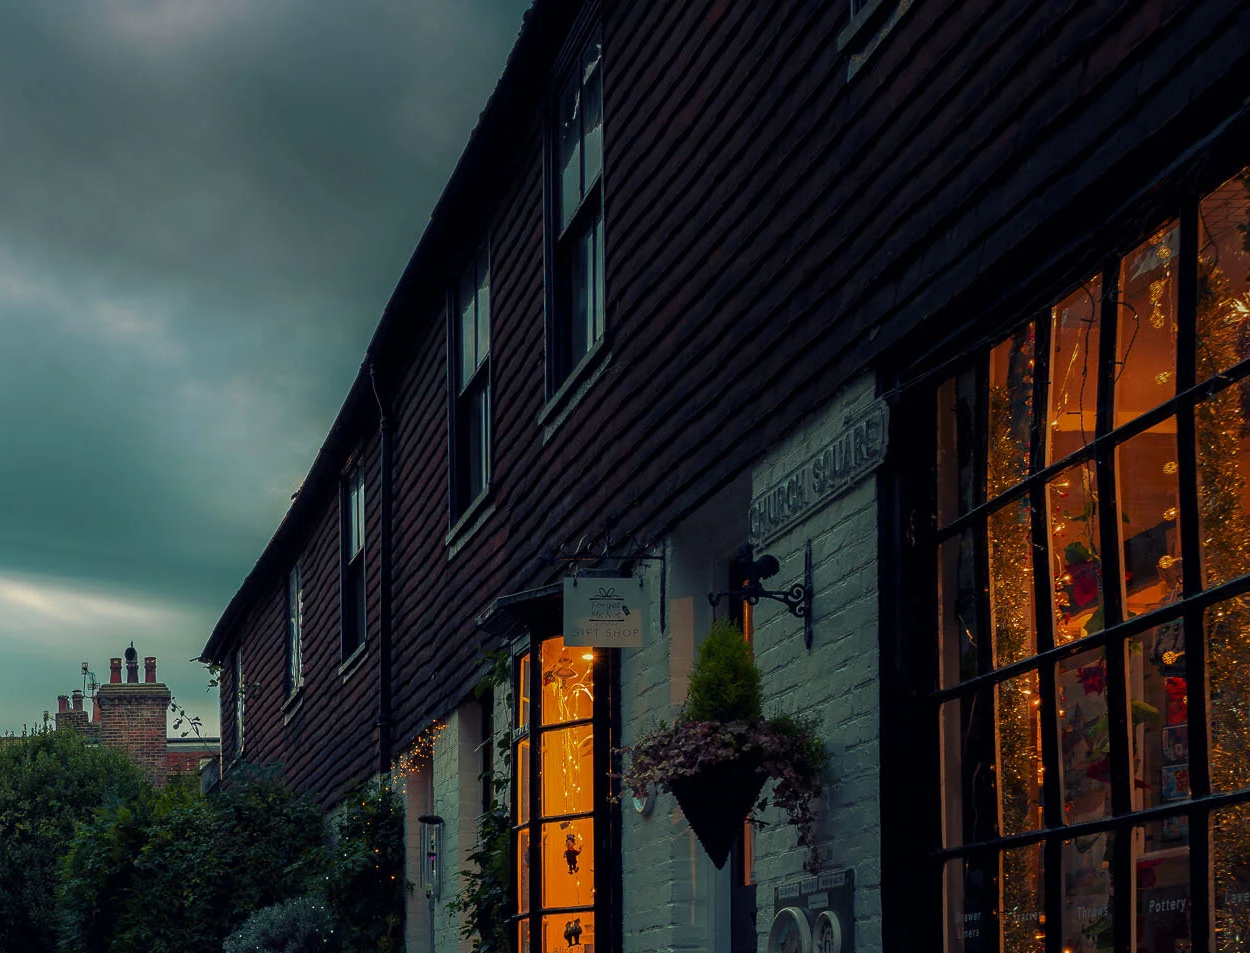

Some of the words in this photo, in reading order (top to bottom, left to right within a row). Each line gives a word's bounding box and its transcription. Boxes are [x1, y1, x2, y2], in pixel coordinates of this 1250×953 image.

[750, 467, 809, 538] CHURCH
[812, 411, 881, 493] SQUARE
[572, 628, 598, 637] GIFT
[606, 628, 639, 638] SHOP
[1077, 905, 1109, 919] Throws
[1149, 897, 1187, 913] Pottery
